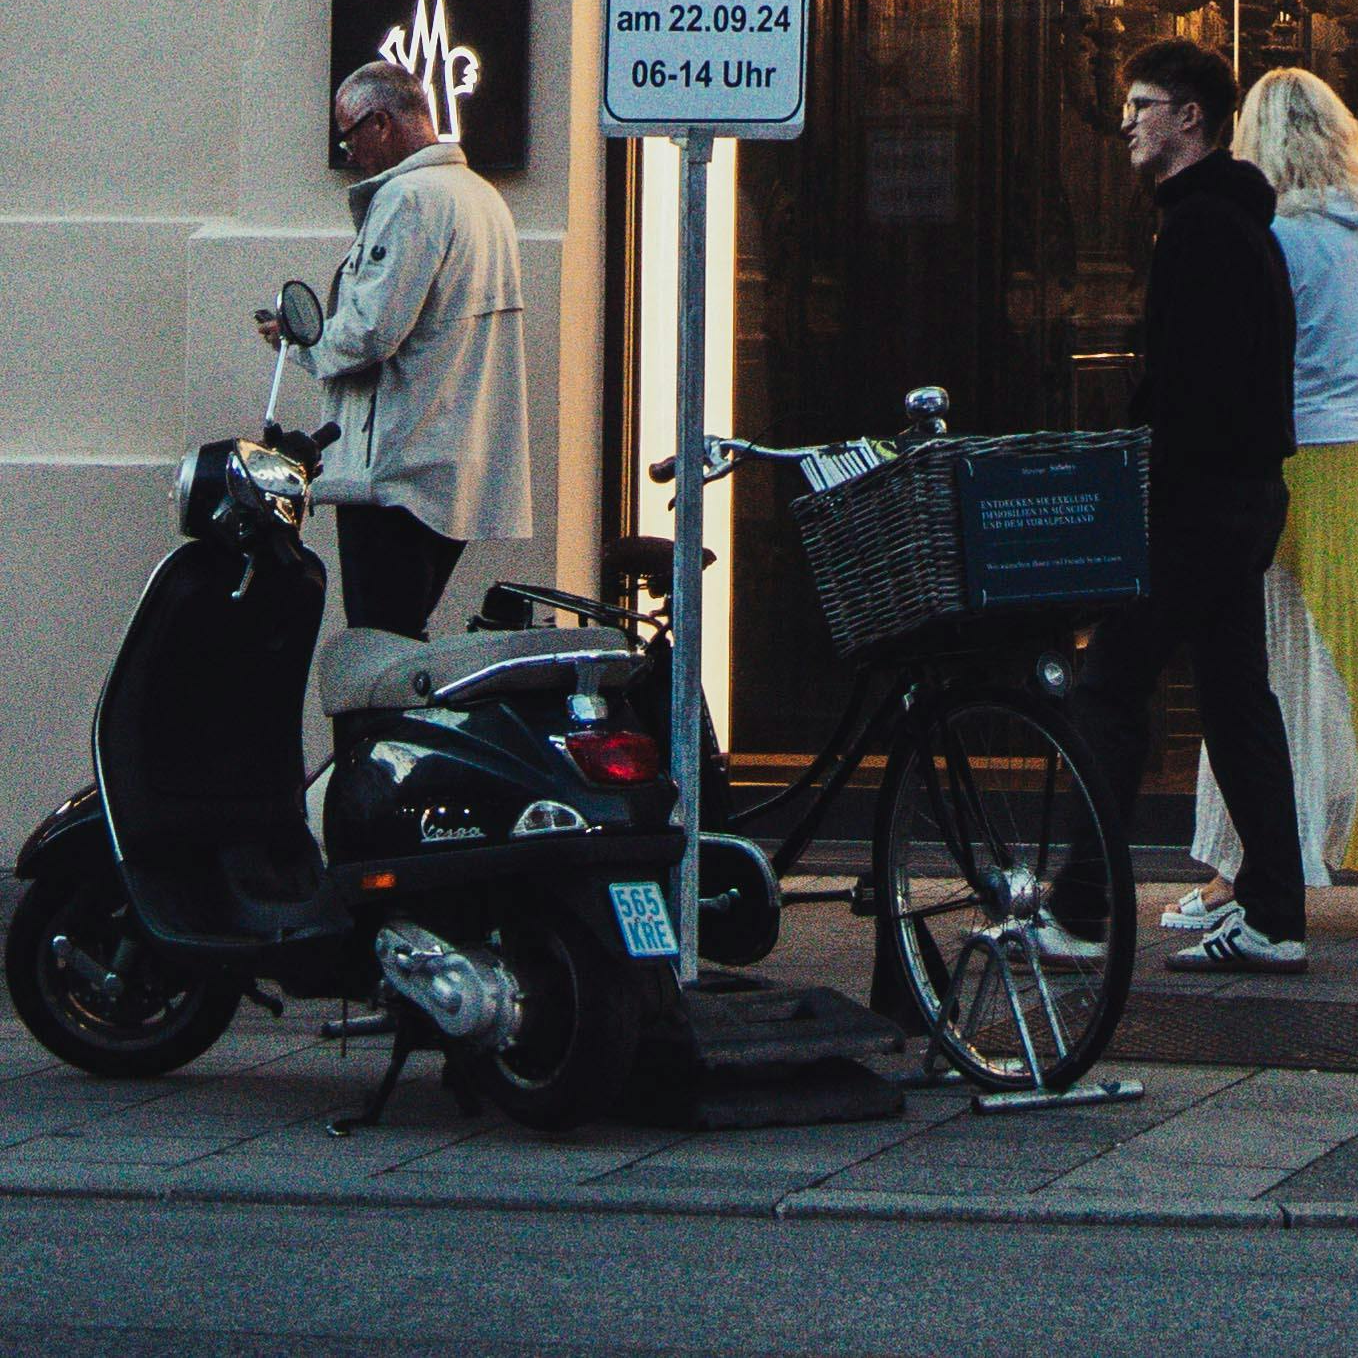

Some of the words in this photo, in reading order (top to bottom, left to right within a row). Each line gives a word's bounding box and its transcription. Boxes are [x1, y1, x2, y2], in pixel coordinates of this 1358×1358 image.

[616, 11, 660, 32] am
[668, 4, 791, 33] 22.09.24
[631, 60, 713, 88] 06-14
[722, 60, 777, 88] Uhr
[615, 888, 660, 918] 565
[628, 920, 673, 950] KRE
